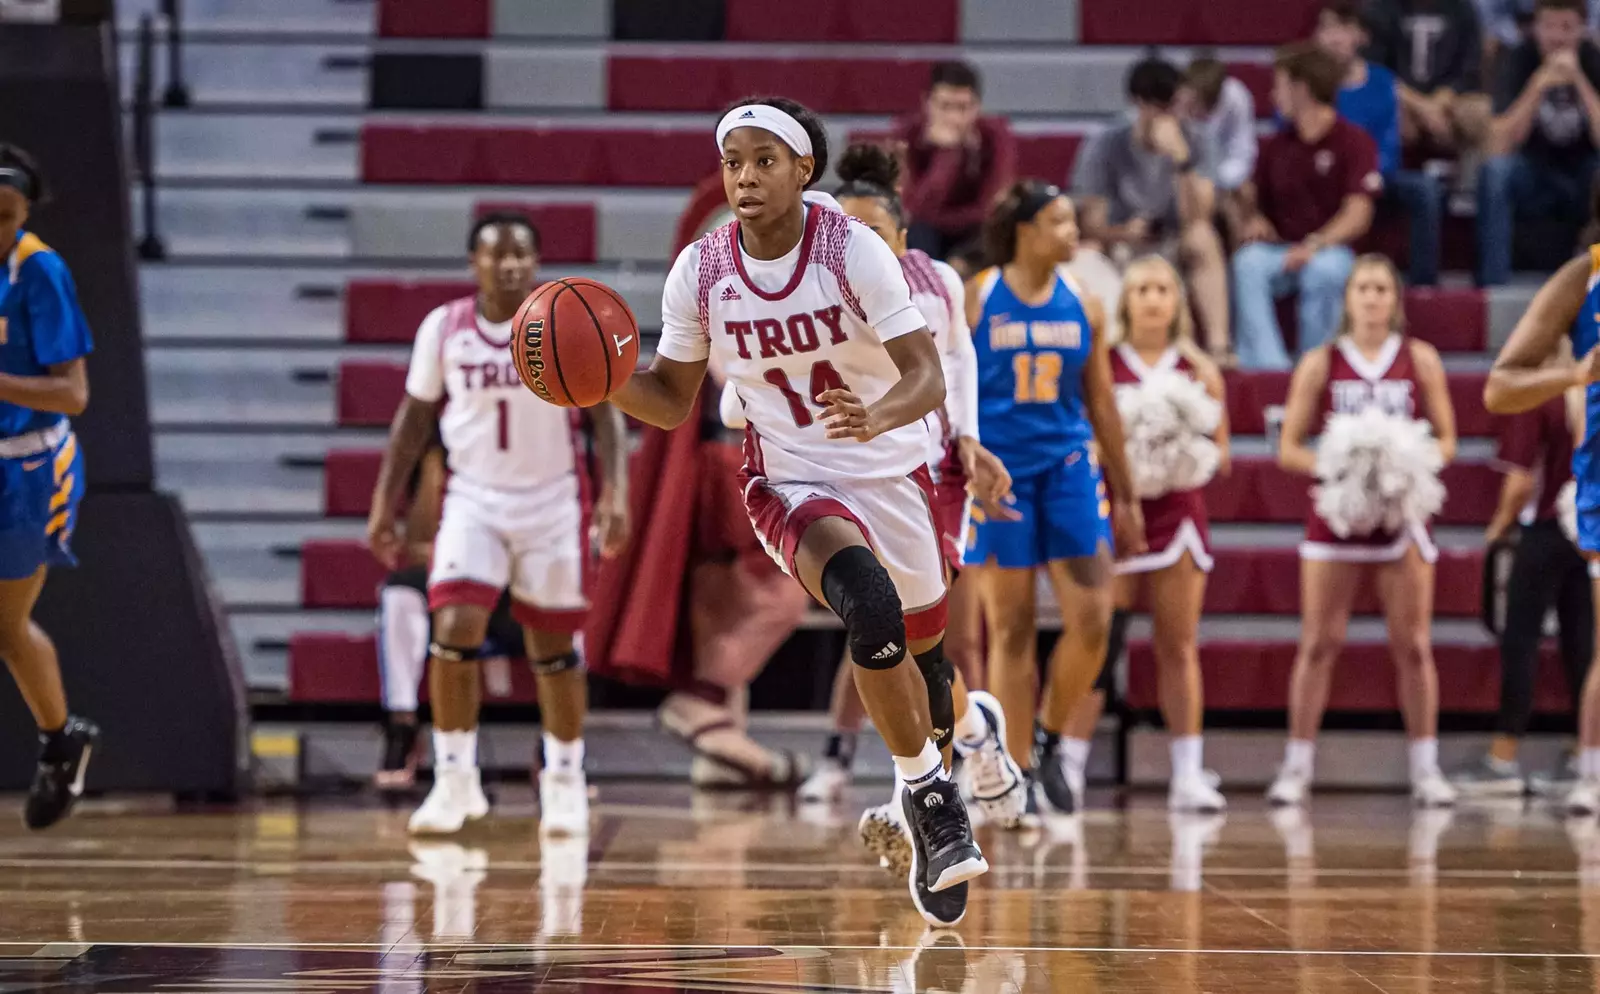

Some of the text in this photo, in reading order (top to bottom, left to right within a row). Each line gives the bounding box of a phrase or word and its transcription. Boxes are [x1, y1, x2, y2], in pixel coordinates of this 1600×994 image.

[1403, 15, 1446, 82] T
[724, 304, 849, 360] TROY
[460, 363, 521, 389] TRO
[524, 319, 556, 402] Wilson
[1012, 351, 1062, 403] 12
[763, 360, 852, 429] 14
[497, 400, 509, 450] 1
